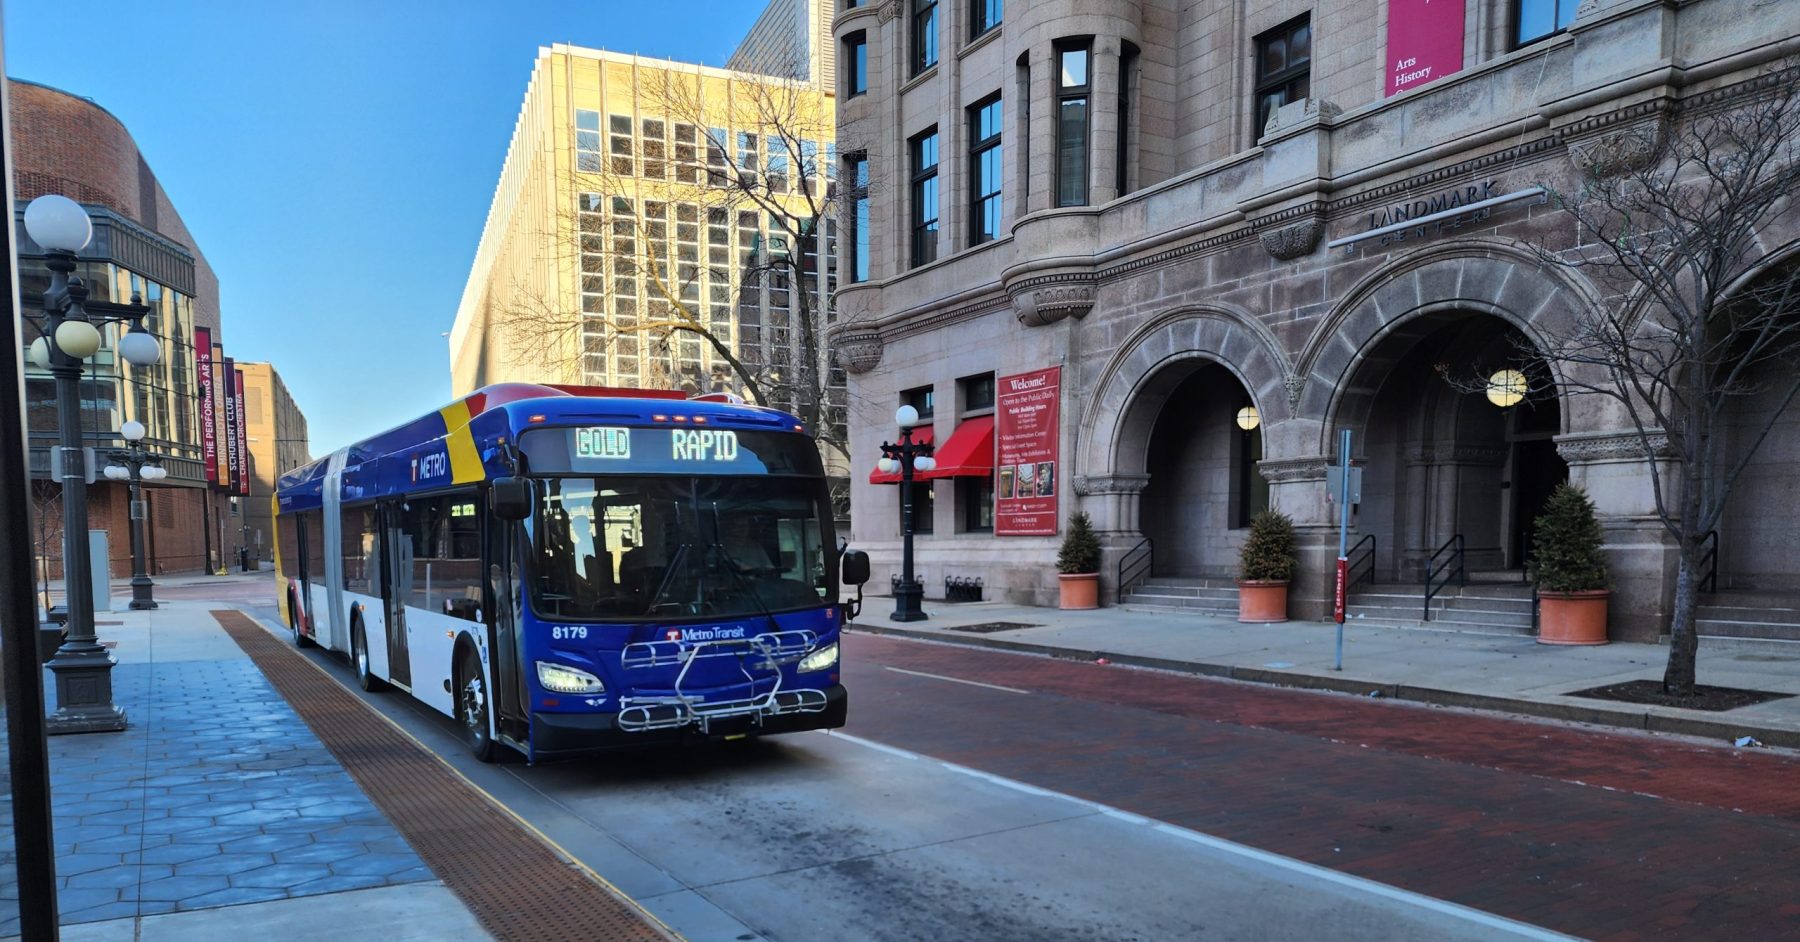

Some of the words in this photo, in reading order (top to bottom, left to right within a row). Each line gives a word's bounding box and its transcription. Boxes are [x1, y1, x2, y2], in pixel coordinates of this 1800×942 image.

[1394, 66, 1432, 87] History
[1395, 57, 1416, 71] Arts
[1368, 180, 1499, 231] LANDMARK
[1381, 213, 1481, 246] CENTER
[214, 375, 224, 409] OPERA
[1010, 375, 1046, 390] Welcome!
[226, 396, 234, 421] CLUB
[236, 393, 245, 439] ORCHESTRA
[206, 440, 215, 458] THE
[216, 411, 227, 465] MINNESOTA
[228, 424, 237, 471] SCHUBERT
[577, 428, 629, 458] GOLD
[672, 429, 738, 460] RAPID
[238, 440, 247, 476] CHAMBER
[419, 451, 446, 480] METRO
[552, 626, 588, 640] 8179
[681, 628, 713, 641] Metro
[712, 626, 744, 639] Transit
